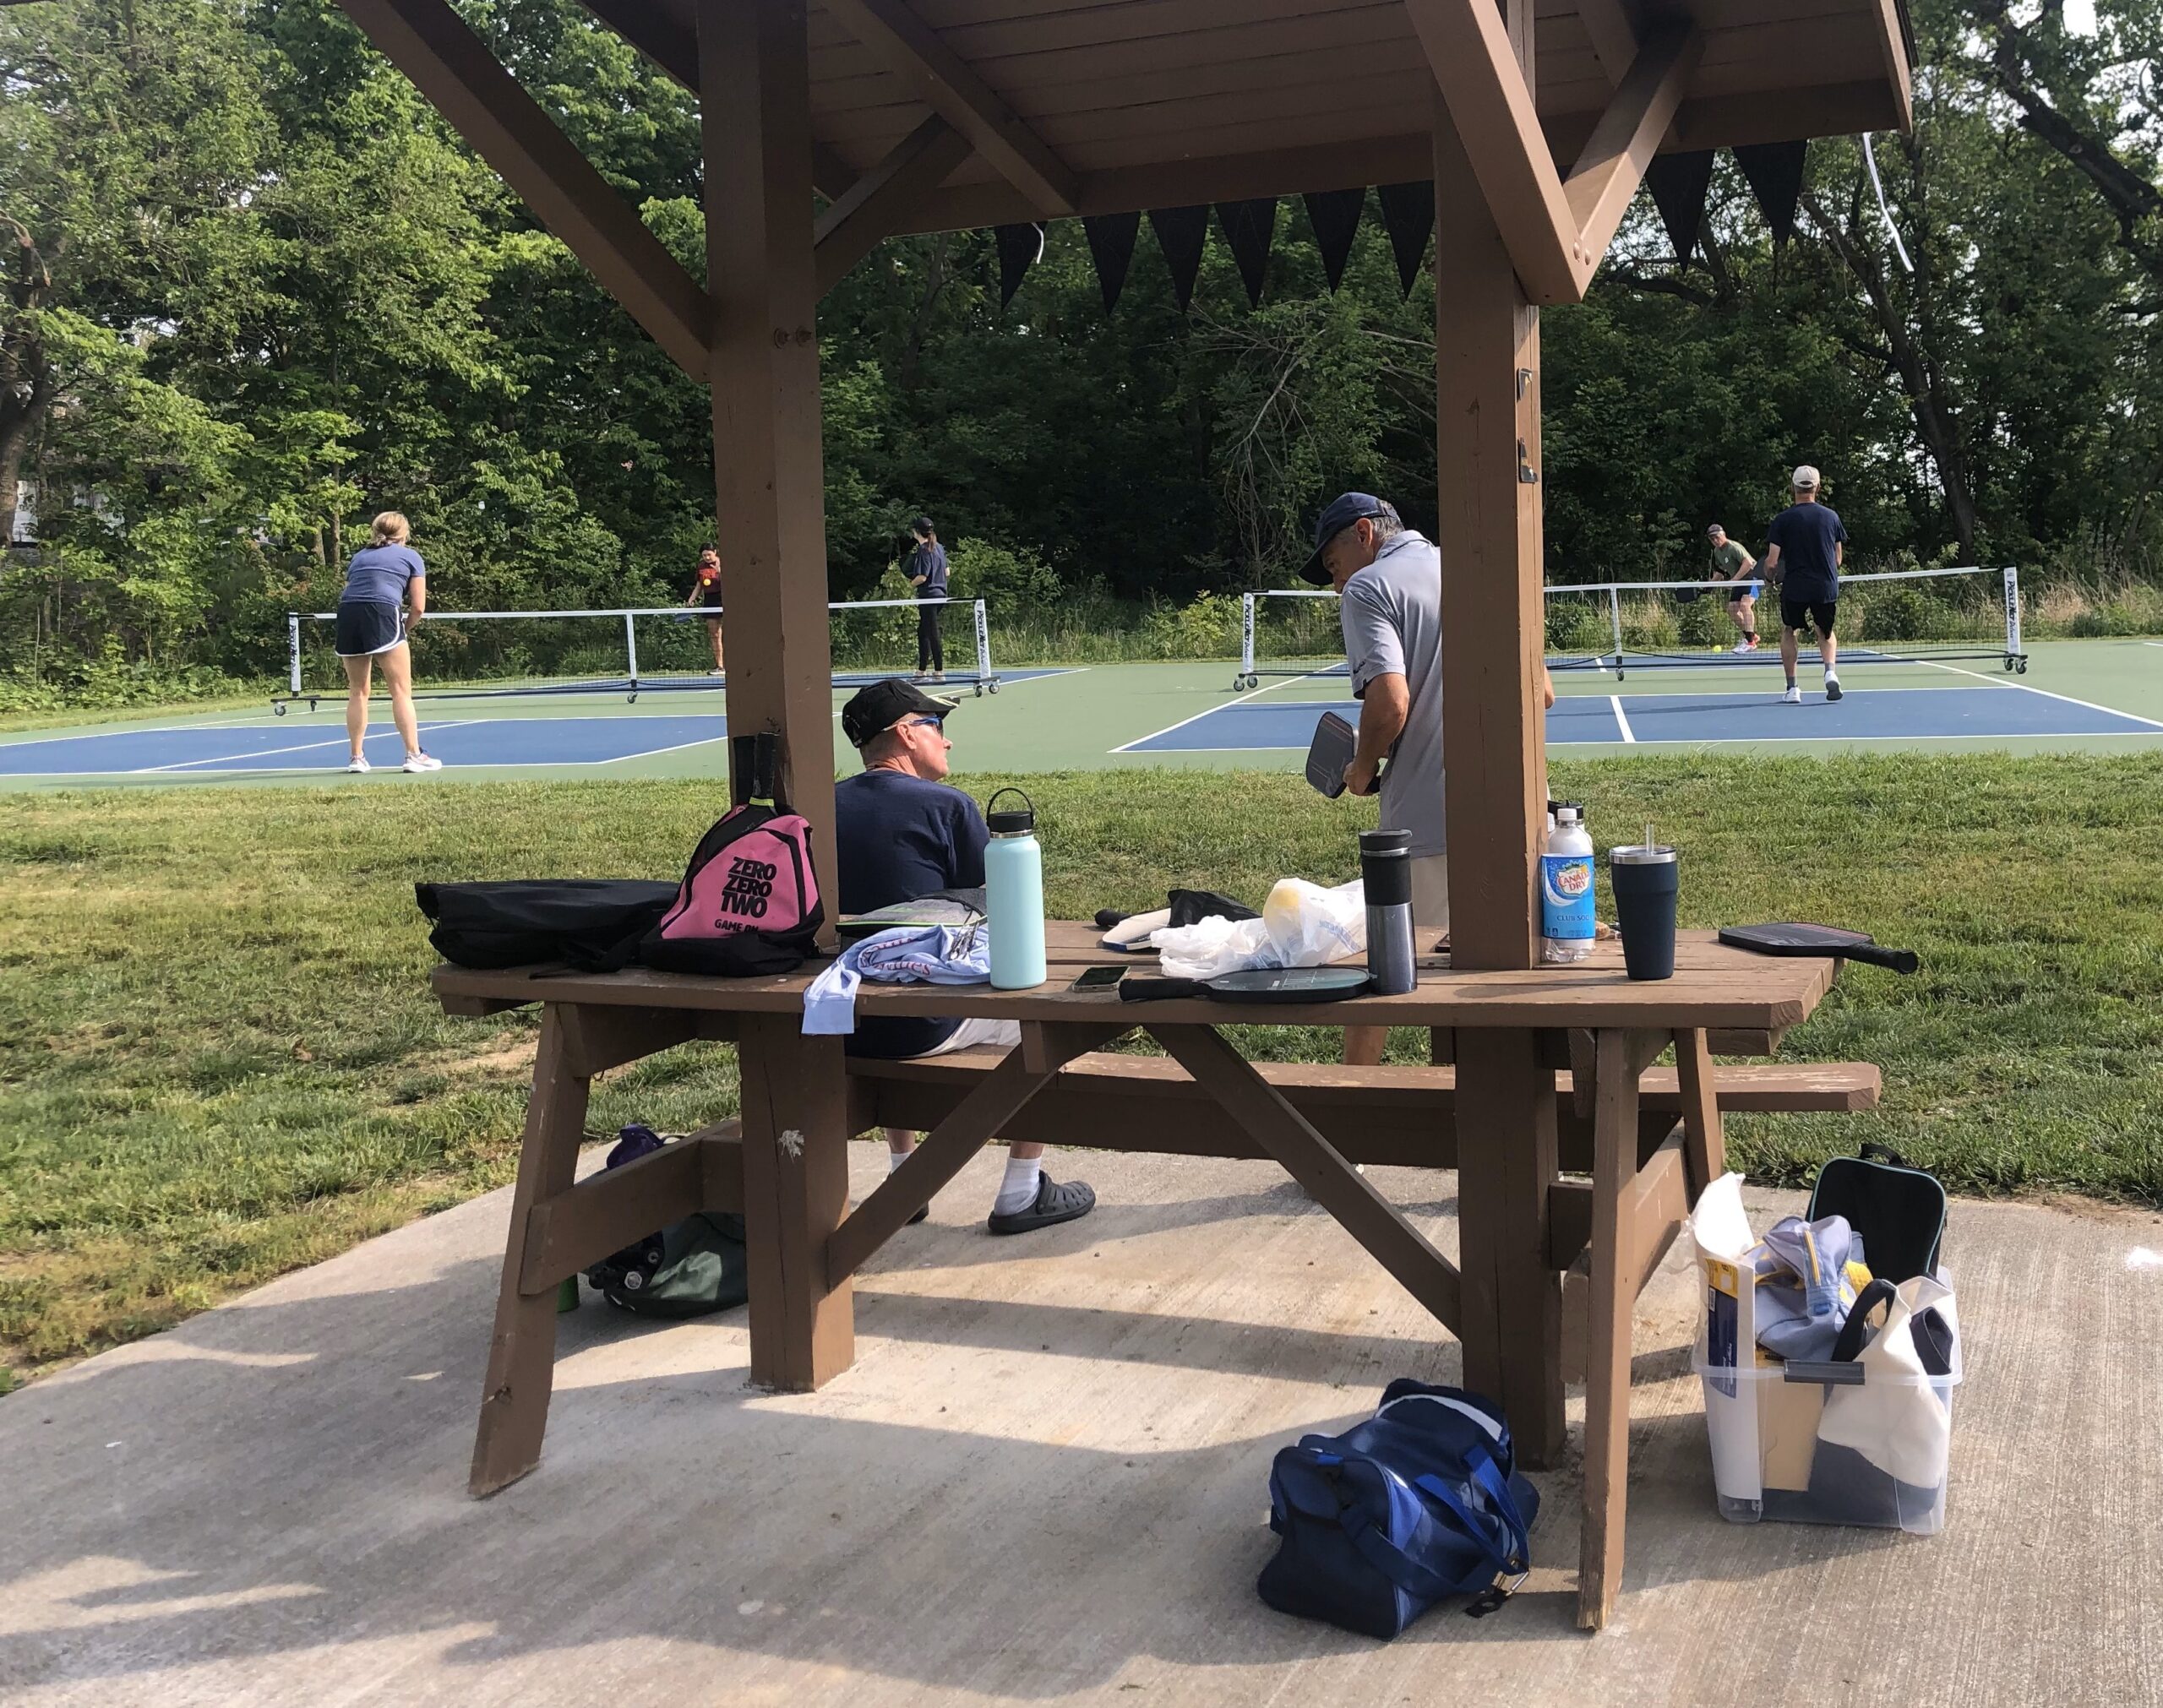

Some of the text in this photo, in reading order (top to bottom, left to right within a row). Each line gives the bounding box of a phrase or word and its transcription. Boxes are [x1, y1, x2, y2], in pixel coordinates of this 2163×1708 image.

[728, 857, 777, 881] ZERO
[723, 873, 772, 898] ZERO
[1558, 872, 1589, 888] CANAD
[1569, 881, 1586, 891] DRY
[721, 890, 768, 918] TWO
[715, 919, 743, 932] GAME
